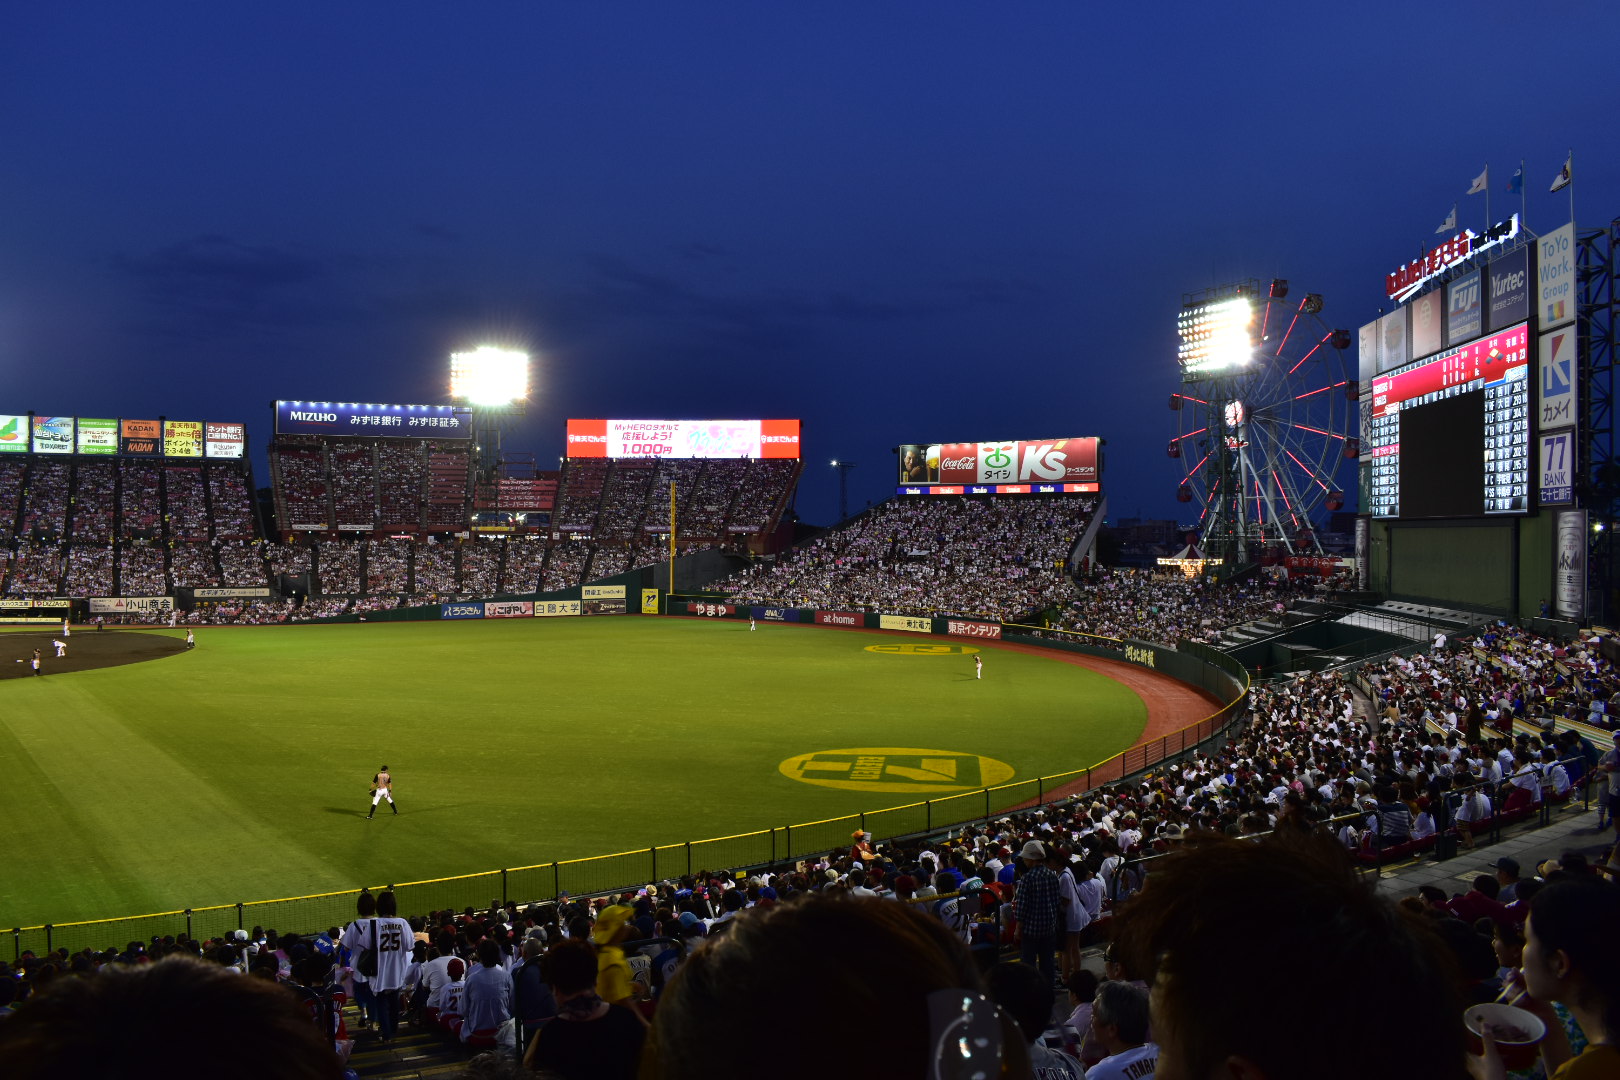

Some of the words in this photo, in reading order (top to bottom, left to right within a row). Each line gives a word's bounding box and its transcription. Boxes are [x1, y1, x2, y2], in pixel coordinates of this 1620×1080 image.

[1542, 235, 1568, 259] ToYo
[1492, 270, 1524, 298] Yurtec
[1450, 276, 1478, 312] Fuji
[1543, 283, 1568, 300] Group
[1543, 398, 1571, 422] カメイ
[290, 411, 336, 422] MIZUHO
[350, 416, 402, 425] みずほ銀行
[409, 417, 459, 427] みずほ証券
[165, 430, 202, 438] 勝ったら倍
[622, 432, 672, 440] 応援しよう!
[128, 443, 154, 452] KADAN
[622, 444, 672, 454] 1,000円
[1544, 436, 1567, 471] 77
[942, 457, 976, 470] Coca-Cola
[1020, 441, 1068, 480] K's
[985, 470, 1010, 479] タイシ
[1544, 472, 1566, 486] BANK
[1540, 488, 1571, 501] 七十七銀行
[127, 600, 171, 610] 小山商会
[497, 606, 526, 614] こばやし
[696, 604, 726, 616] やまや
[452, 607, 480, 616] ろうきん
[906, 620, 930, 630] 東北電力
[948, 621, 1000, 636] 東京インテリア
[380, 933, 400, 952] 25
